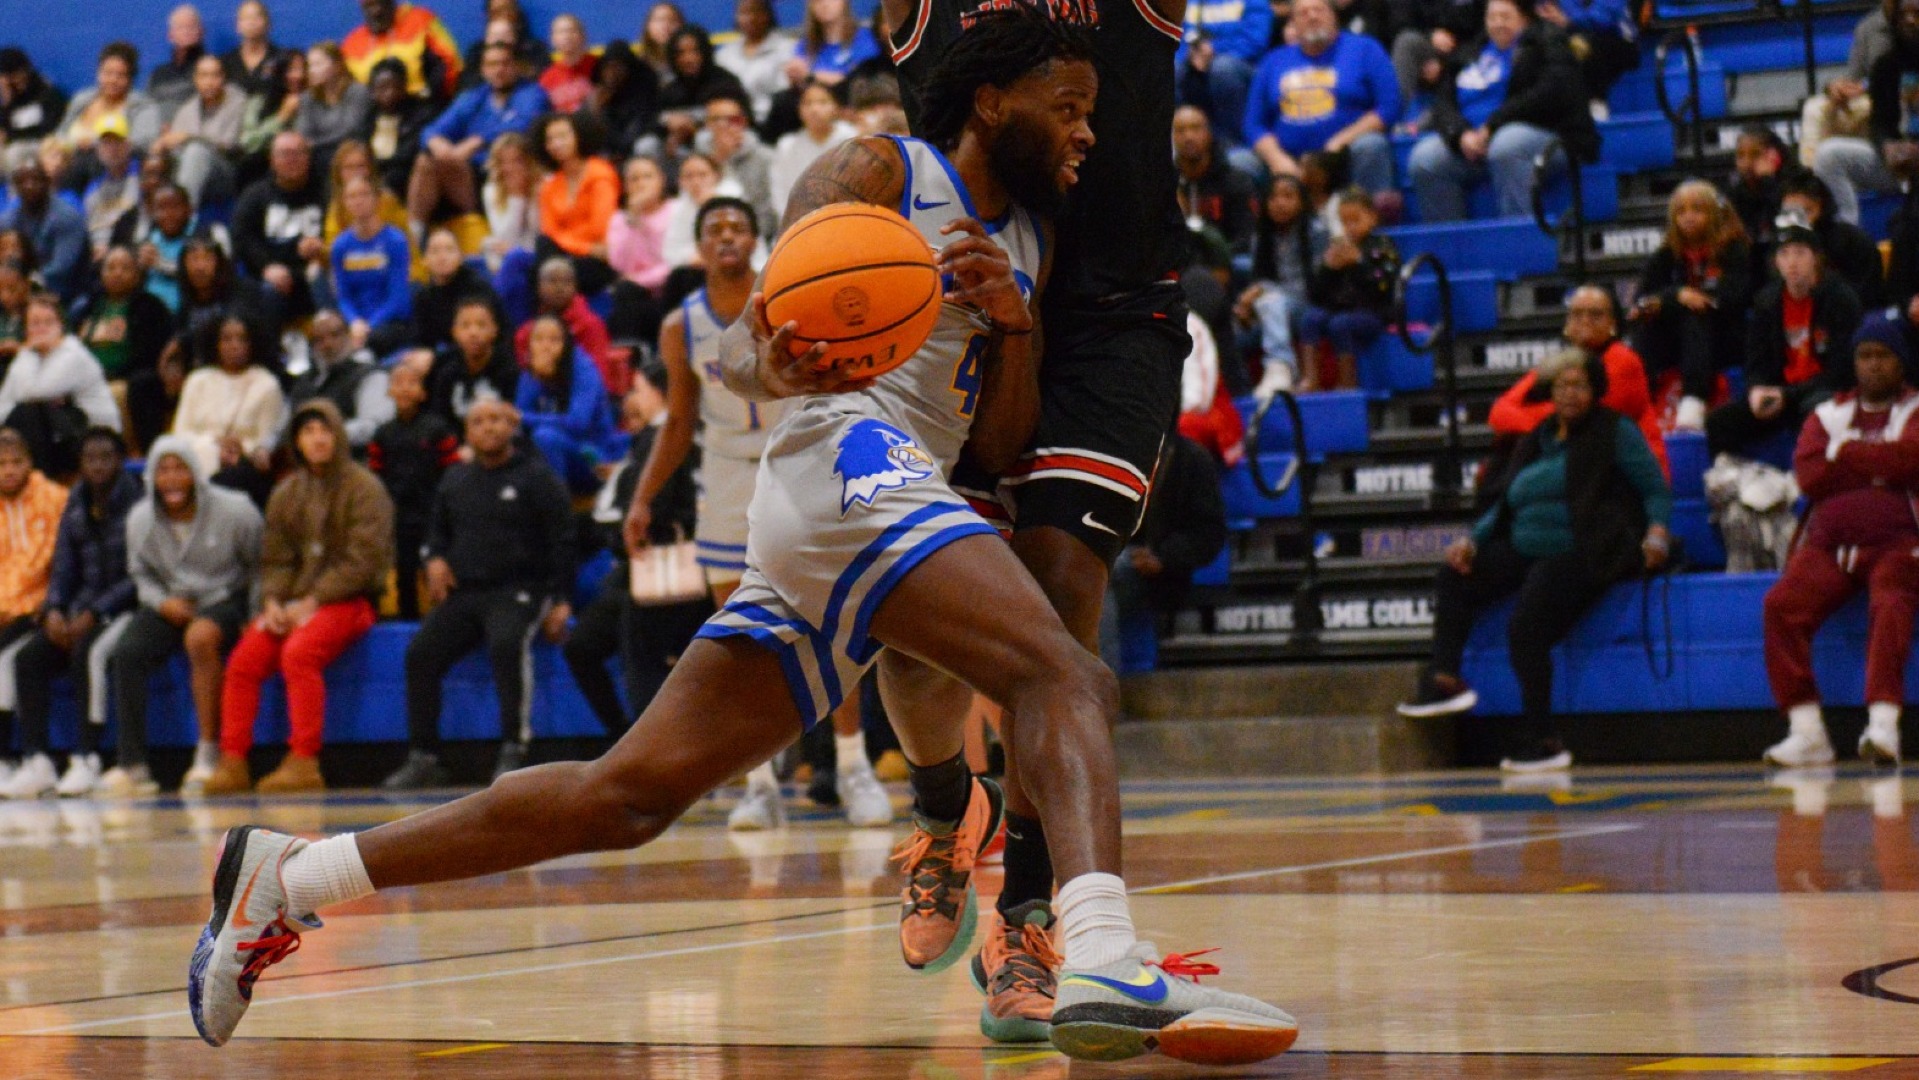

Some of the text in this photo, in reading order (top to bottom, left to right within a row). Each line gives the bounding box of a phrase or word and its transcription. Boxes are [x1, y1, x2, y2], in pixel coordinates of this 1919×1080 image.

[1604, 230, 1662, 256] NOTR
[949, 330, 986, 418] 4
[1355, 464, 1433, 493] NOTRE
[1215, 605, 1294, 632] NOTRE
[1372, 597, 1435, 625] COLL
